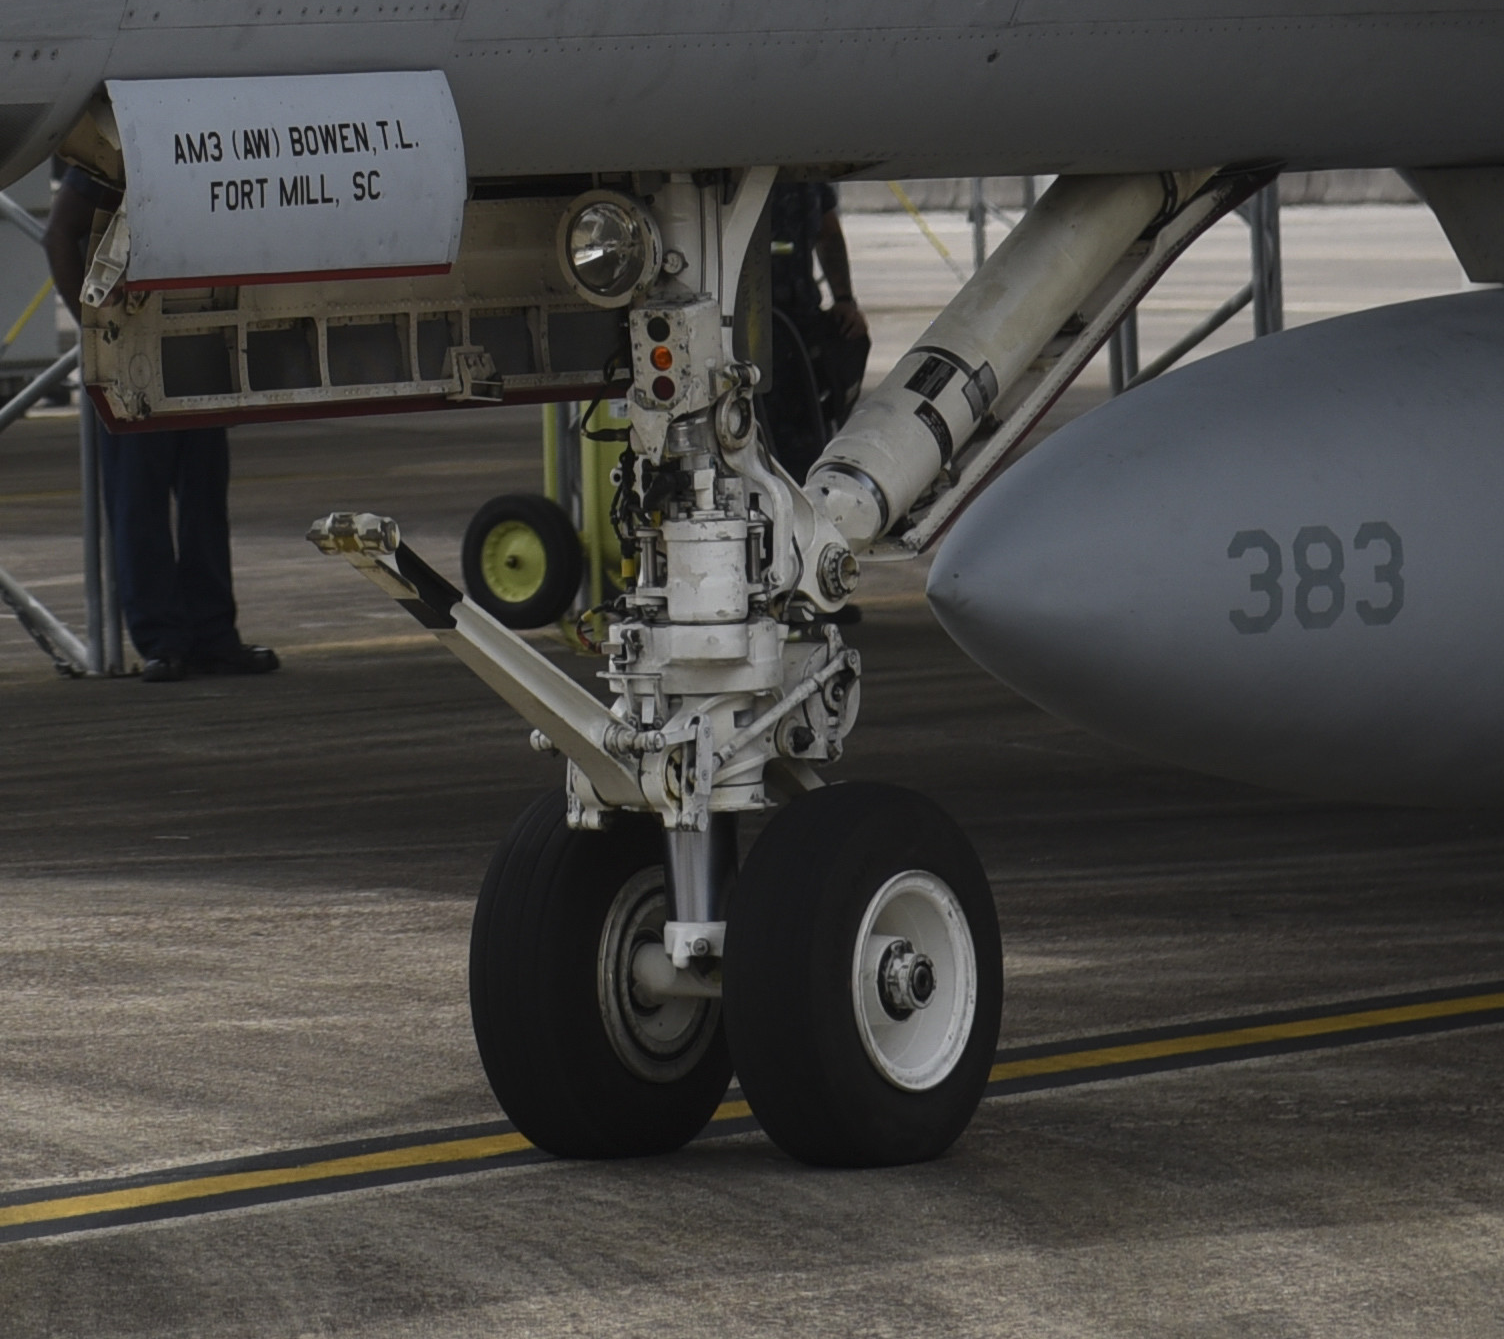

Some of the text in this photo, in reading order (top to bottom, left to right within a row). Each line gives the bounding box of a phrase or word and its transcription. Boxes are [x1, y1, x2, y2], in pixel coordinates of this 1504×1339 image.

[174, 131, 223, 165] AM3
[232, 127, 280, 161] (AW)
[210, 169, 381, 213] FORT MILL, SC
[1226, 521, 1405, 635] 383
